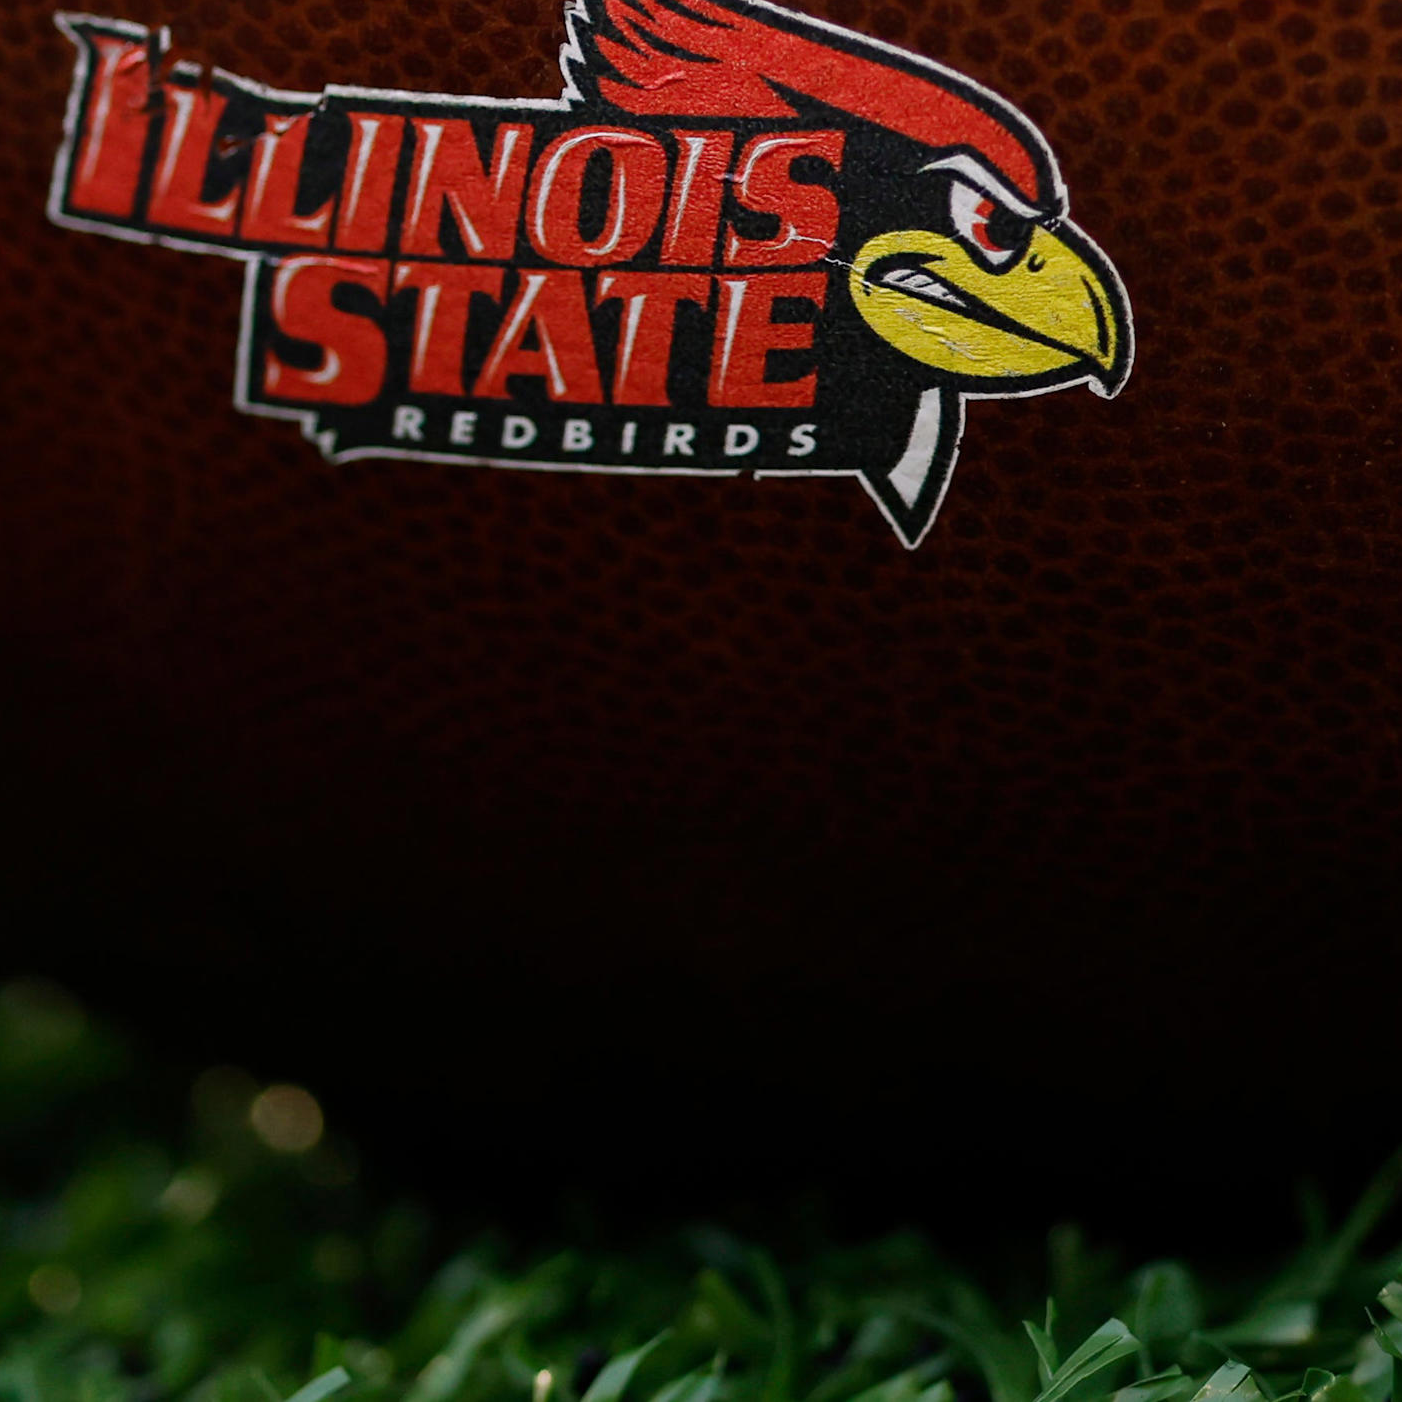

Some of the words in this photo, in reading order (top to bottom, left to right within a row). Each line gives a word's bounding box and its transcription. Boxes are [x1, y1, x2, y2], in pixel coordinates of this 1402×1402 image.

[70, 34, 845, 268] ILLINOIS
[262, 254, 828, 410] STATE
[392, 405, 818, 458] REDBIRDS
